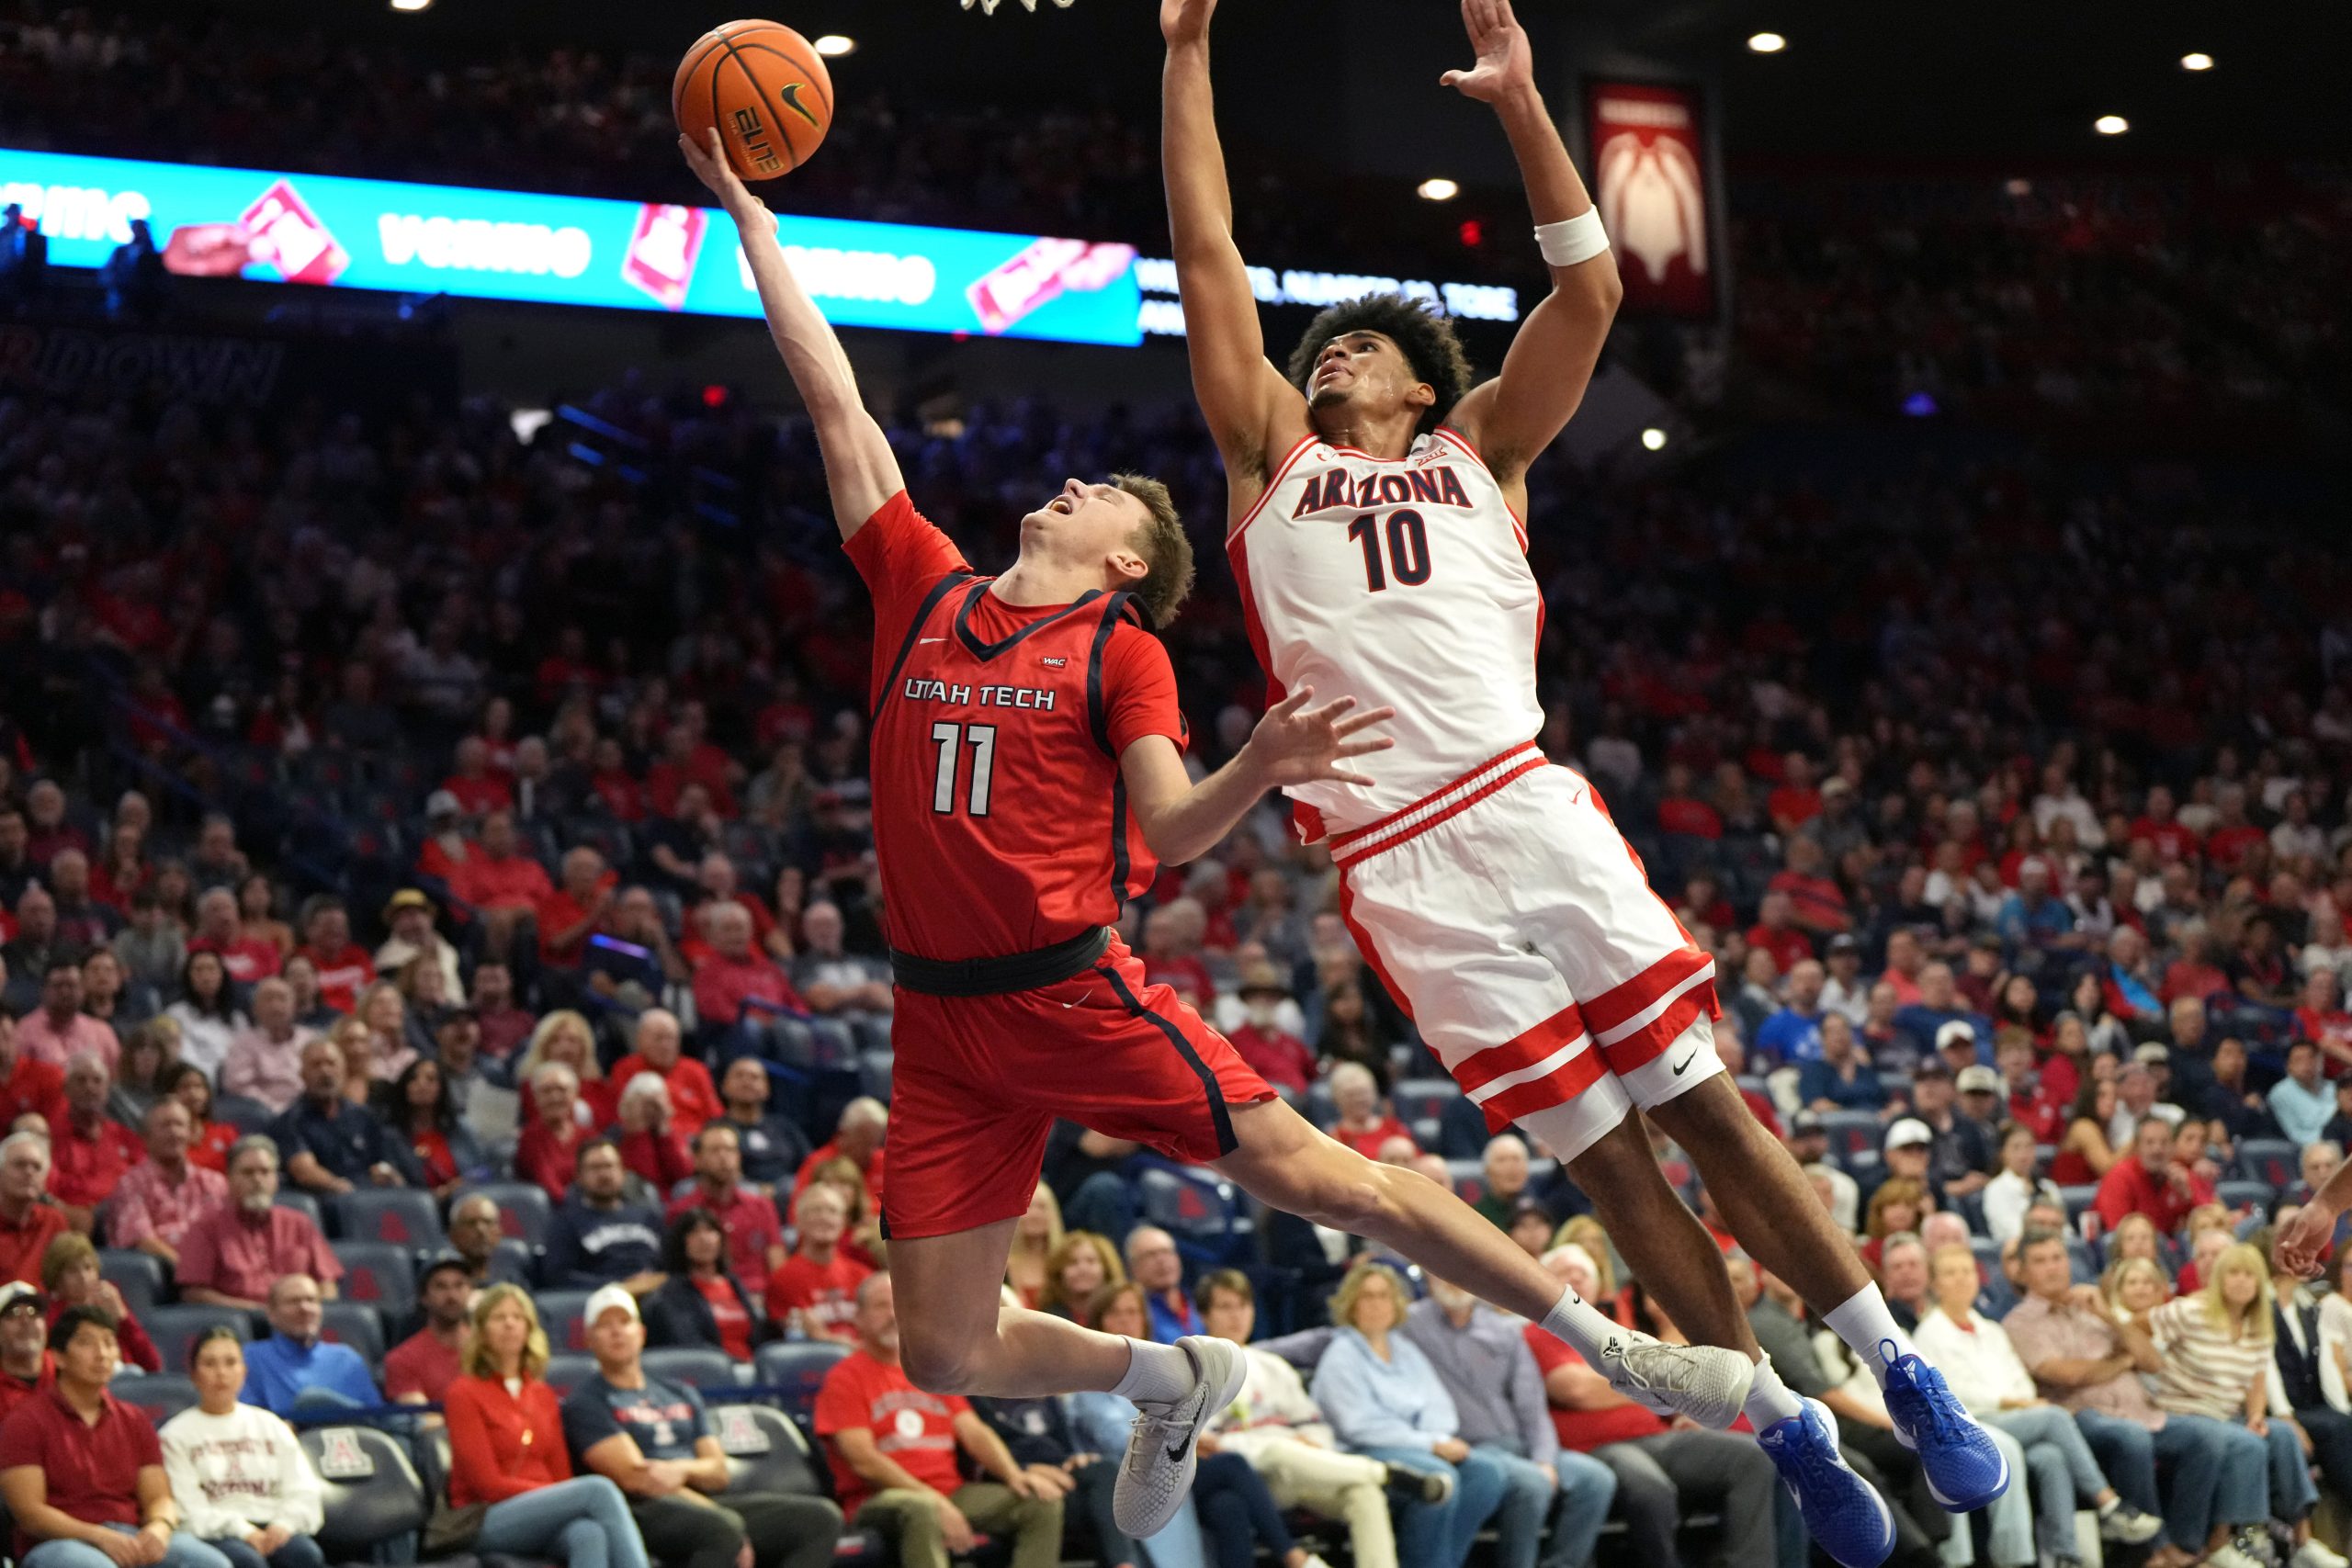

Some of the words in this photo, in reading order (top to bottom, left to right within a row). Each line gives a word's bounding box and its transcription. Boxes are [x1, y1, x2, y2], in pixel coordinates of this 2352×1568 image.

[735, 106, 785, 173] ELITE
[1291, 466, 1473, 519] ARIZONA
[1347, 508, 1431, 593] 10
[1043, 657, 1066, 667] WAC
[905, 678, 970, 705] UTAH
[979, 686, 1056, 711] TECH
[932, 722, 997, 816] 11
